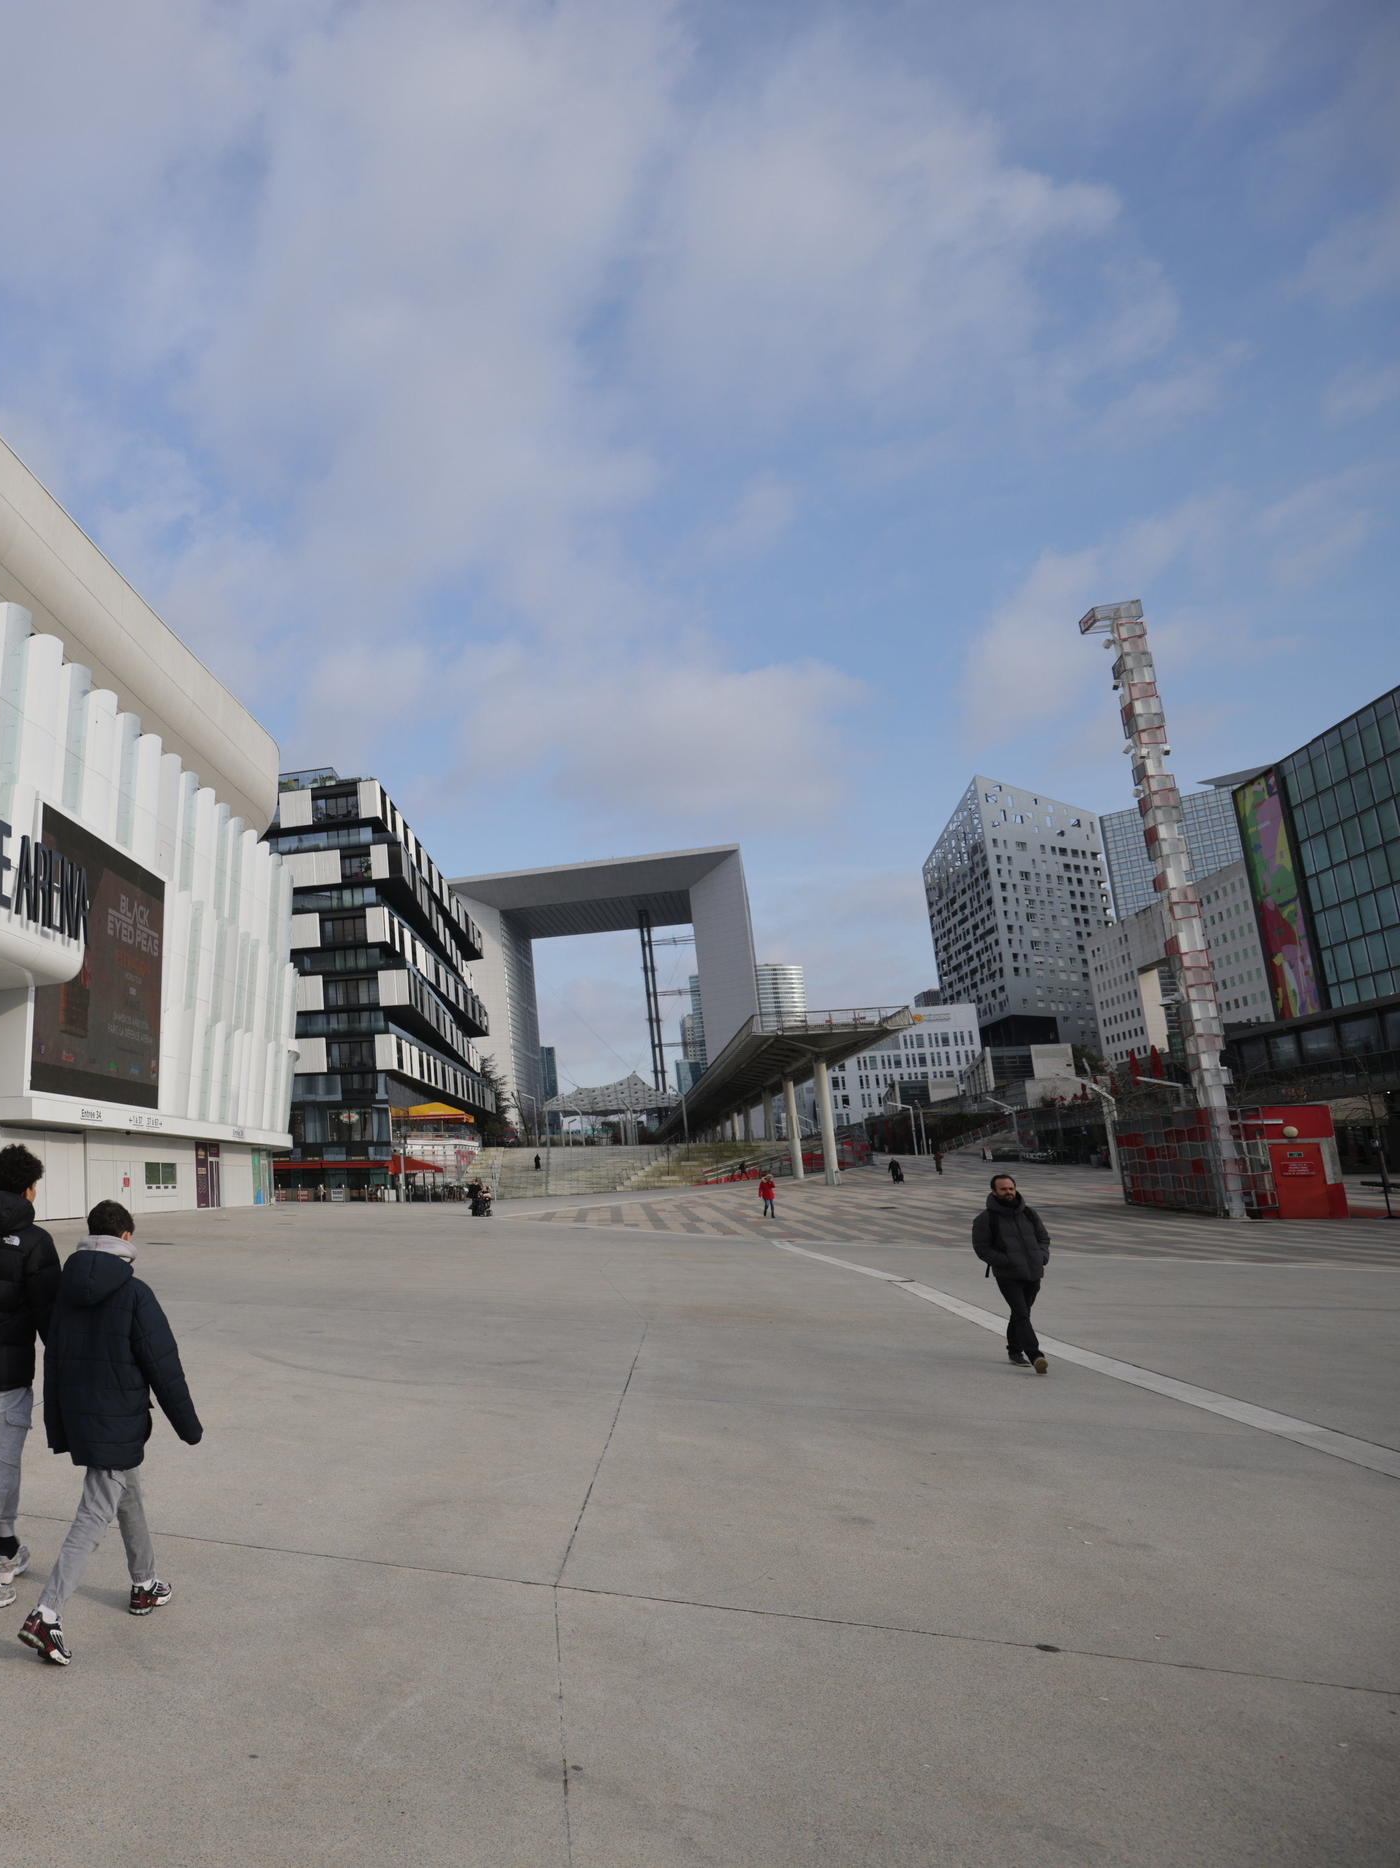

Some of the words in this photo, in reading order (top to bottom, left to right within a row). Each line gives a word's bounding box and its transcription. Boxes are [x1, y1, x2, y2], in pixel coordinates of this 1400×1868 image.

[14, 835, 90, 945] ARENA
[120, 894, 150, 928] BLACK
[107, 914, 135, 945] EYED
[135, 929, 159, 957] PEAS
